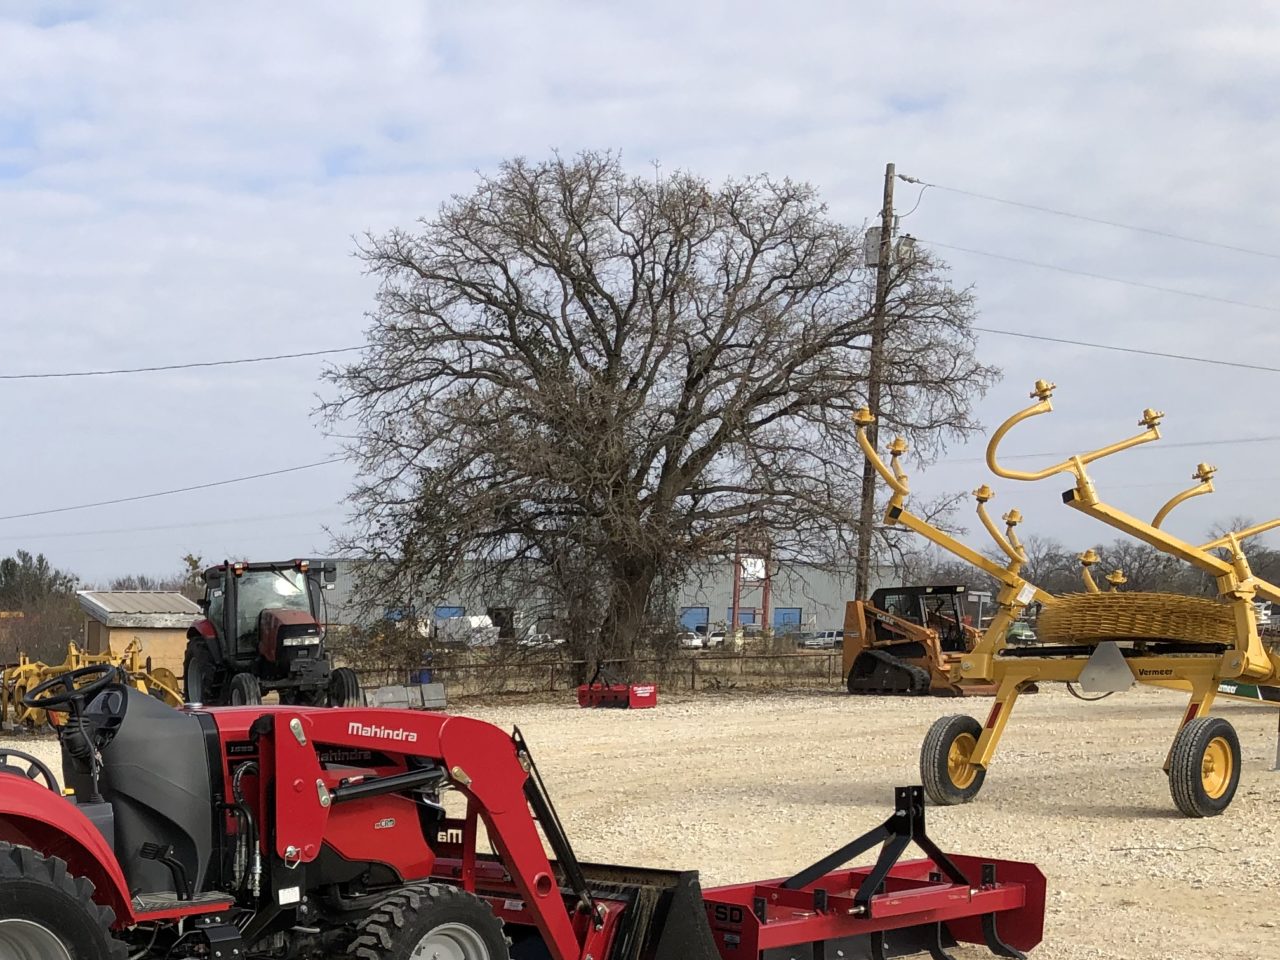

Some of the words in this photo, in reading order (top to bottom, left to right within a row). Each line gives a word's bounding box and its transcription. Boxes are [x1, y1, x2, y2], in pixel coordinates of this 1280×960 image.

[1138, 668, 1173, 676] Vermeer
[348, 722, 417, 741] Mahindra
[317, 748, 371, 762] ahindra
